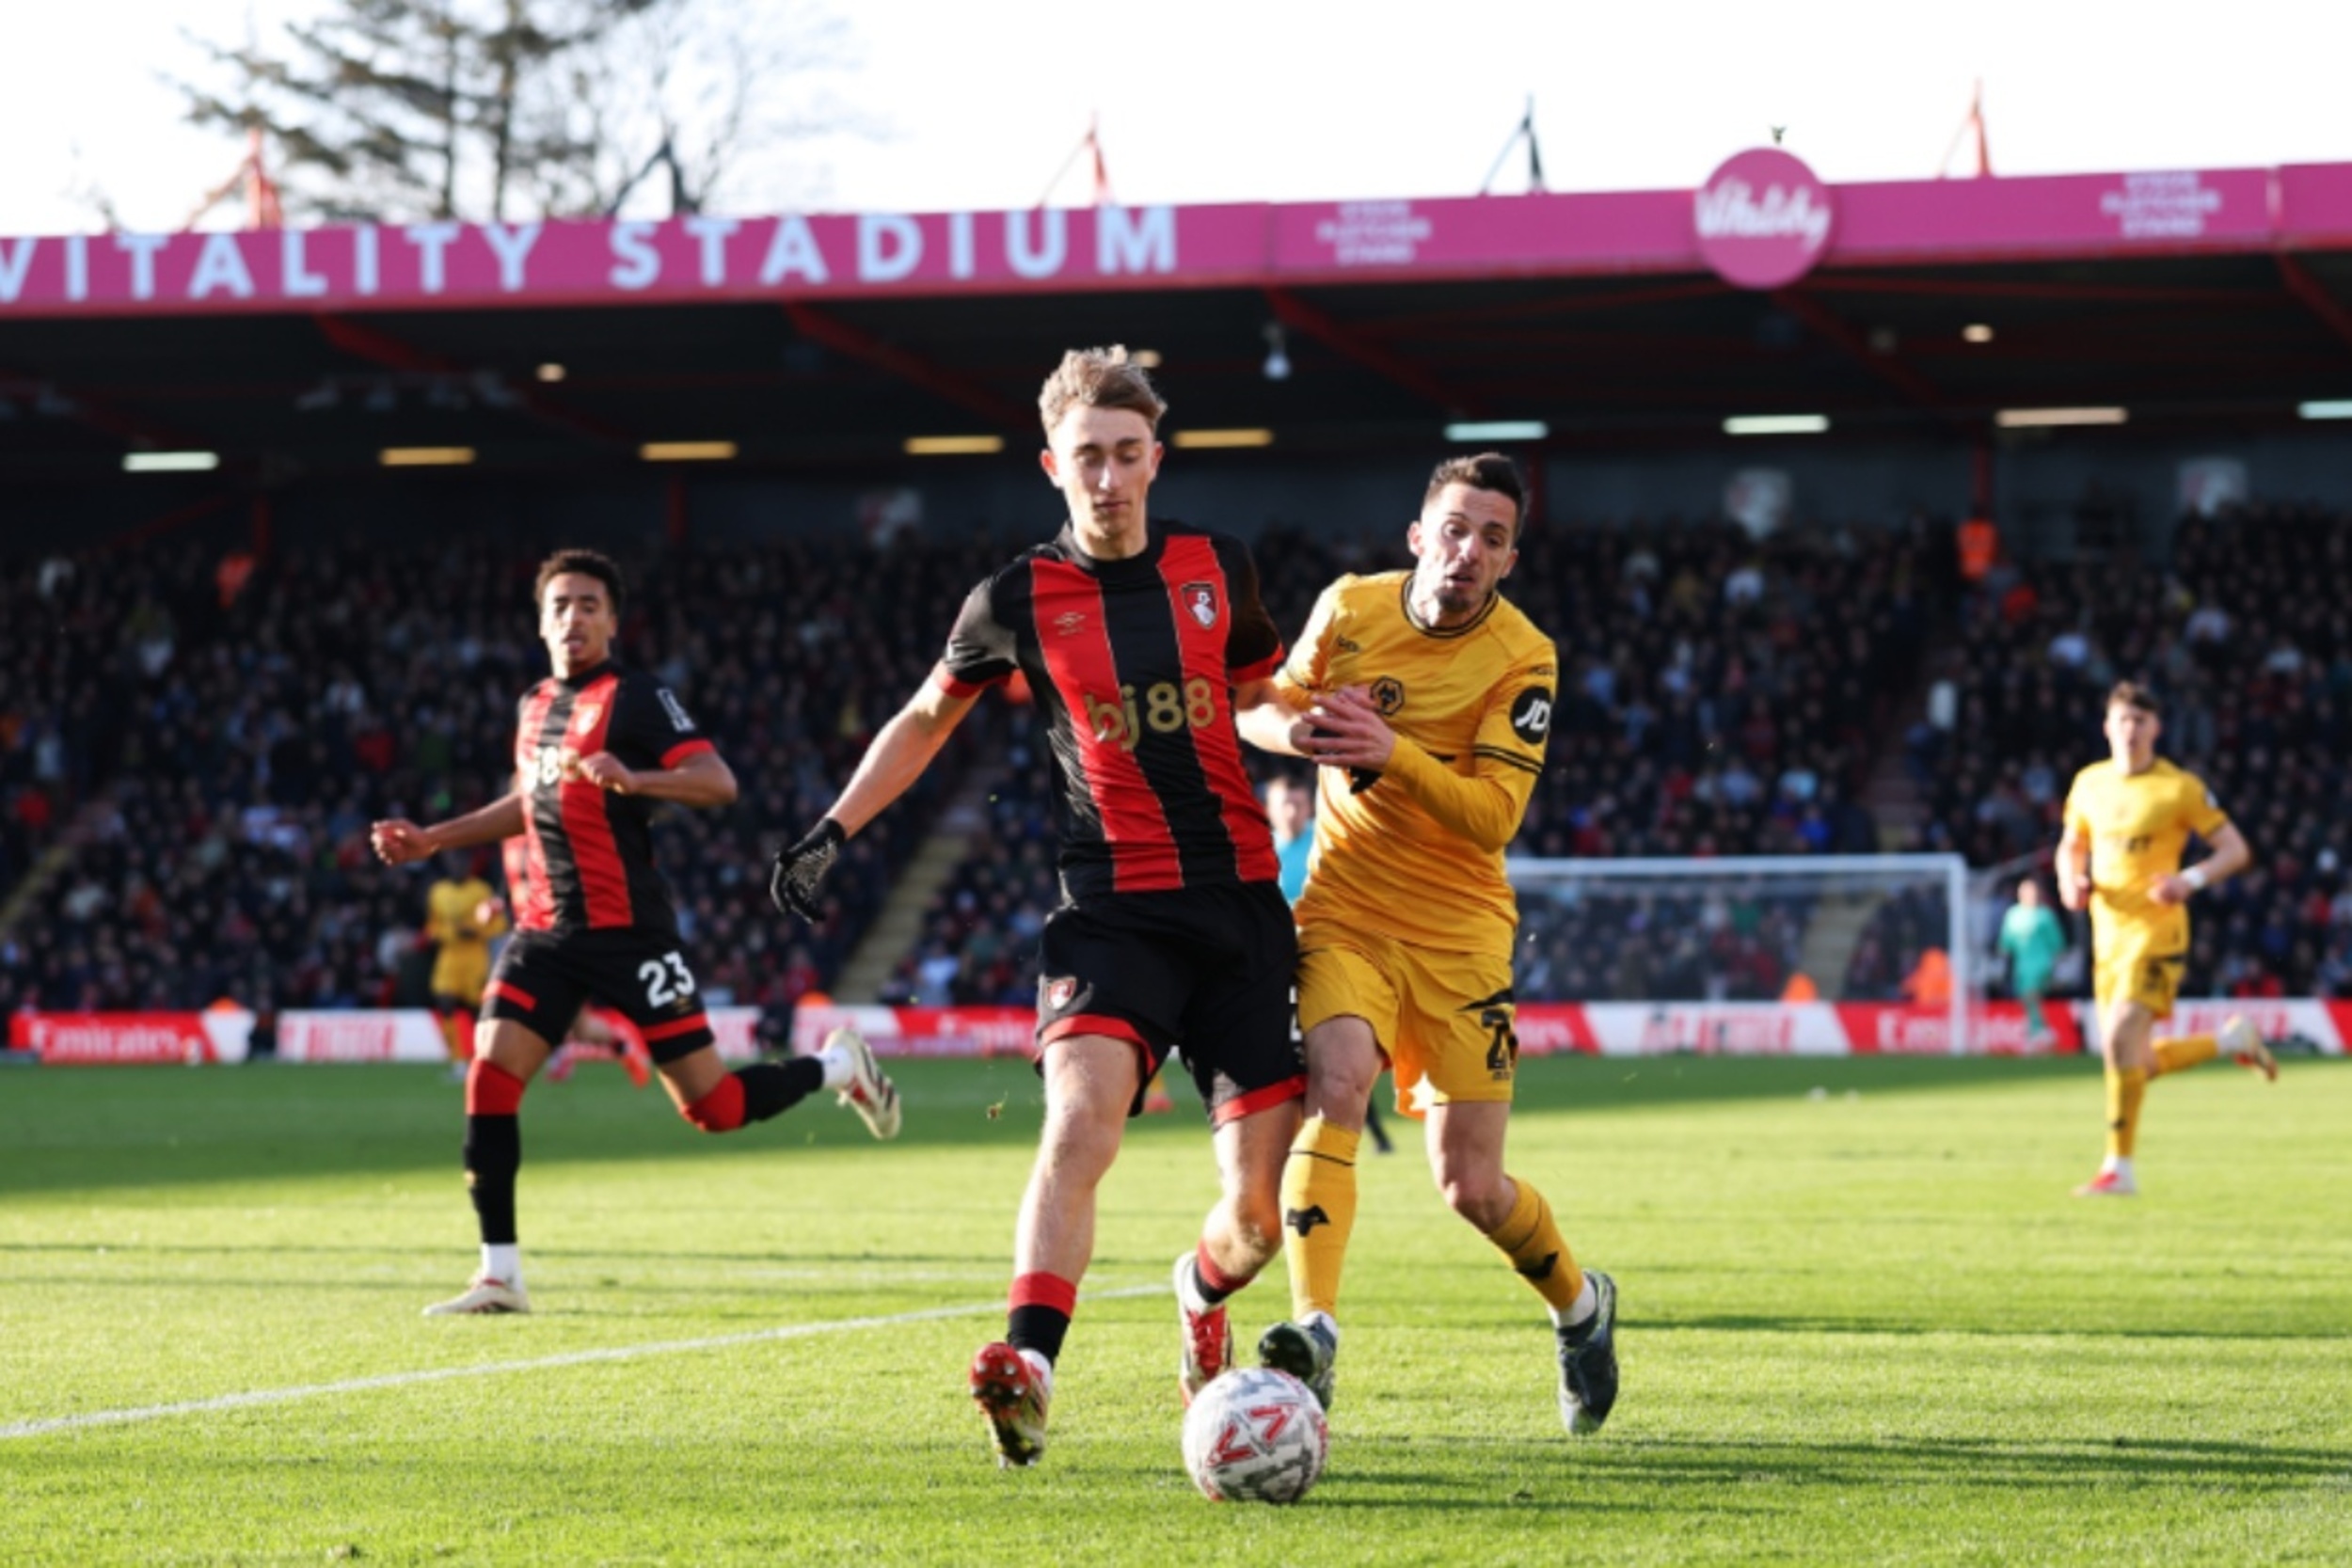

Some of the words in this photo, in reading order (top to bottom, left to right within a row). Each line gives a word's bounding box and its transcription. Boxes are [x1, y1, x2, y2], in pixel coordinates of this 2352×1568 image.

[0, 222, 543, 303] VITALITY
[609, 204, 1178, 288] STADIUM
[1084, 676, 1216, 752] bj88
[1514, 698, 1551, 732] JD
[638, 949, 695, 1009] 23
